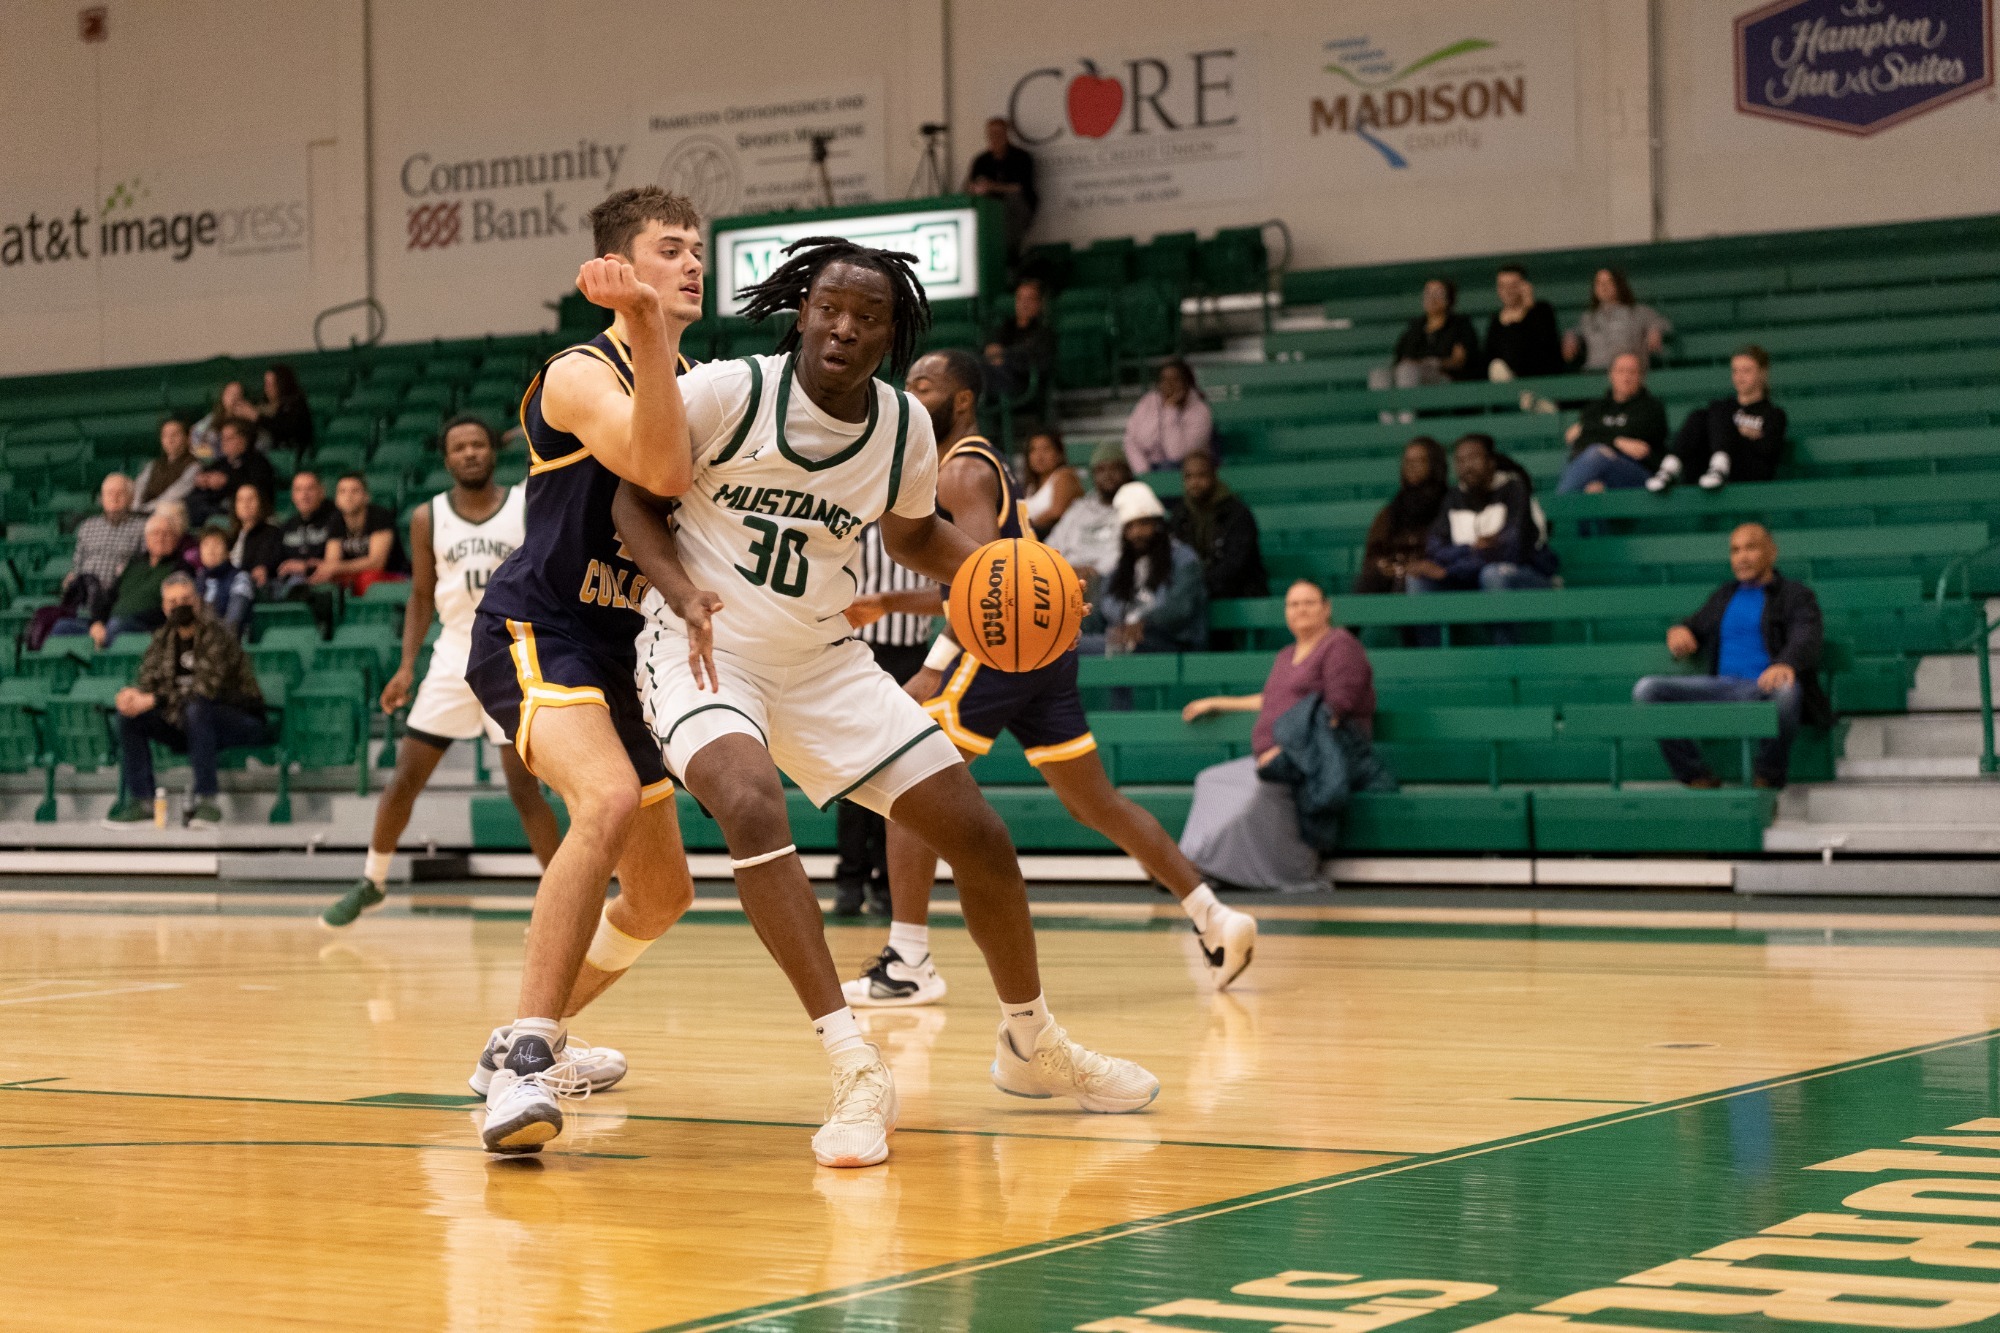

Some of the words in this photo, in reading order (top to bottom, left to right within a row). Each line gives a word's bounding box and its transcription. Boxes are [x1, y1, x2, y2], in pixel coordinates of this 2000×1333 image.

[1771, 13, 1947, 68] Hampton
[1310, 76, 1525, 137] MADISON
[1765, 63, 1850, 106] Inn
[1871, 52, 1966, 92] Suites
[401, 139, 626, 198] Community
[1, 207, 89, 266] at&t
[473, 189, 568, 243] Bank
[734, 515, 809, 598] 30
[980, 558, 1007, 648] Wilson
[1033, 575, 1051, 630] EVO
